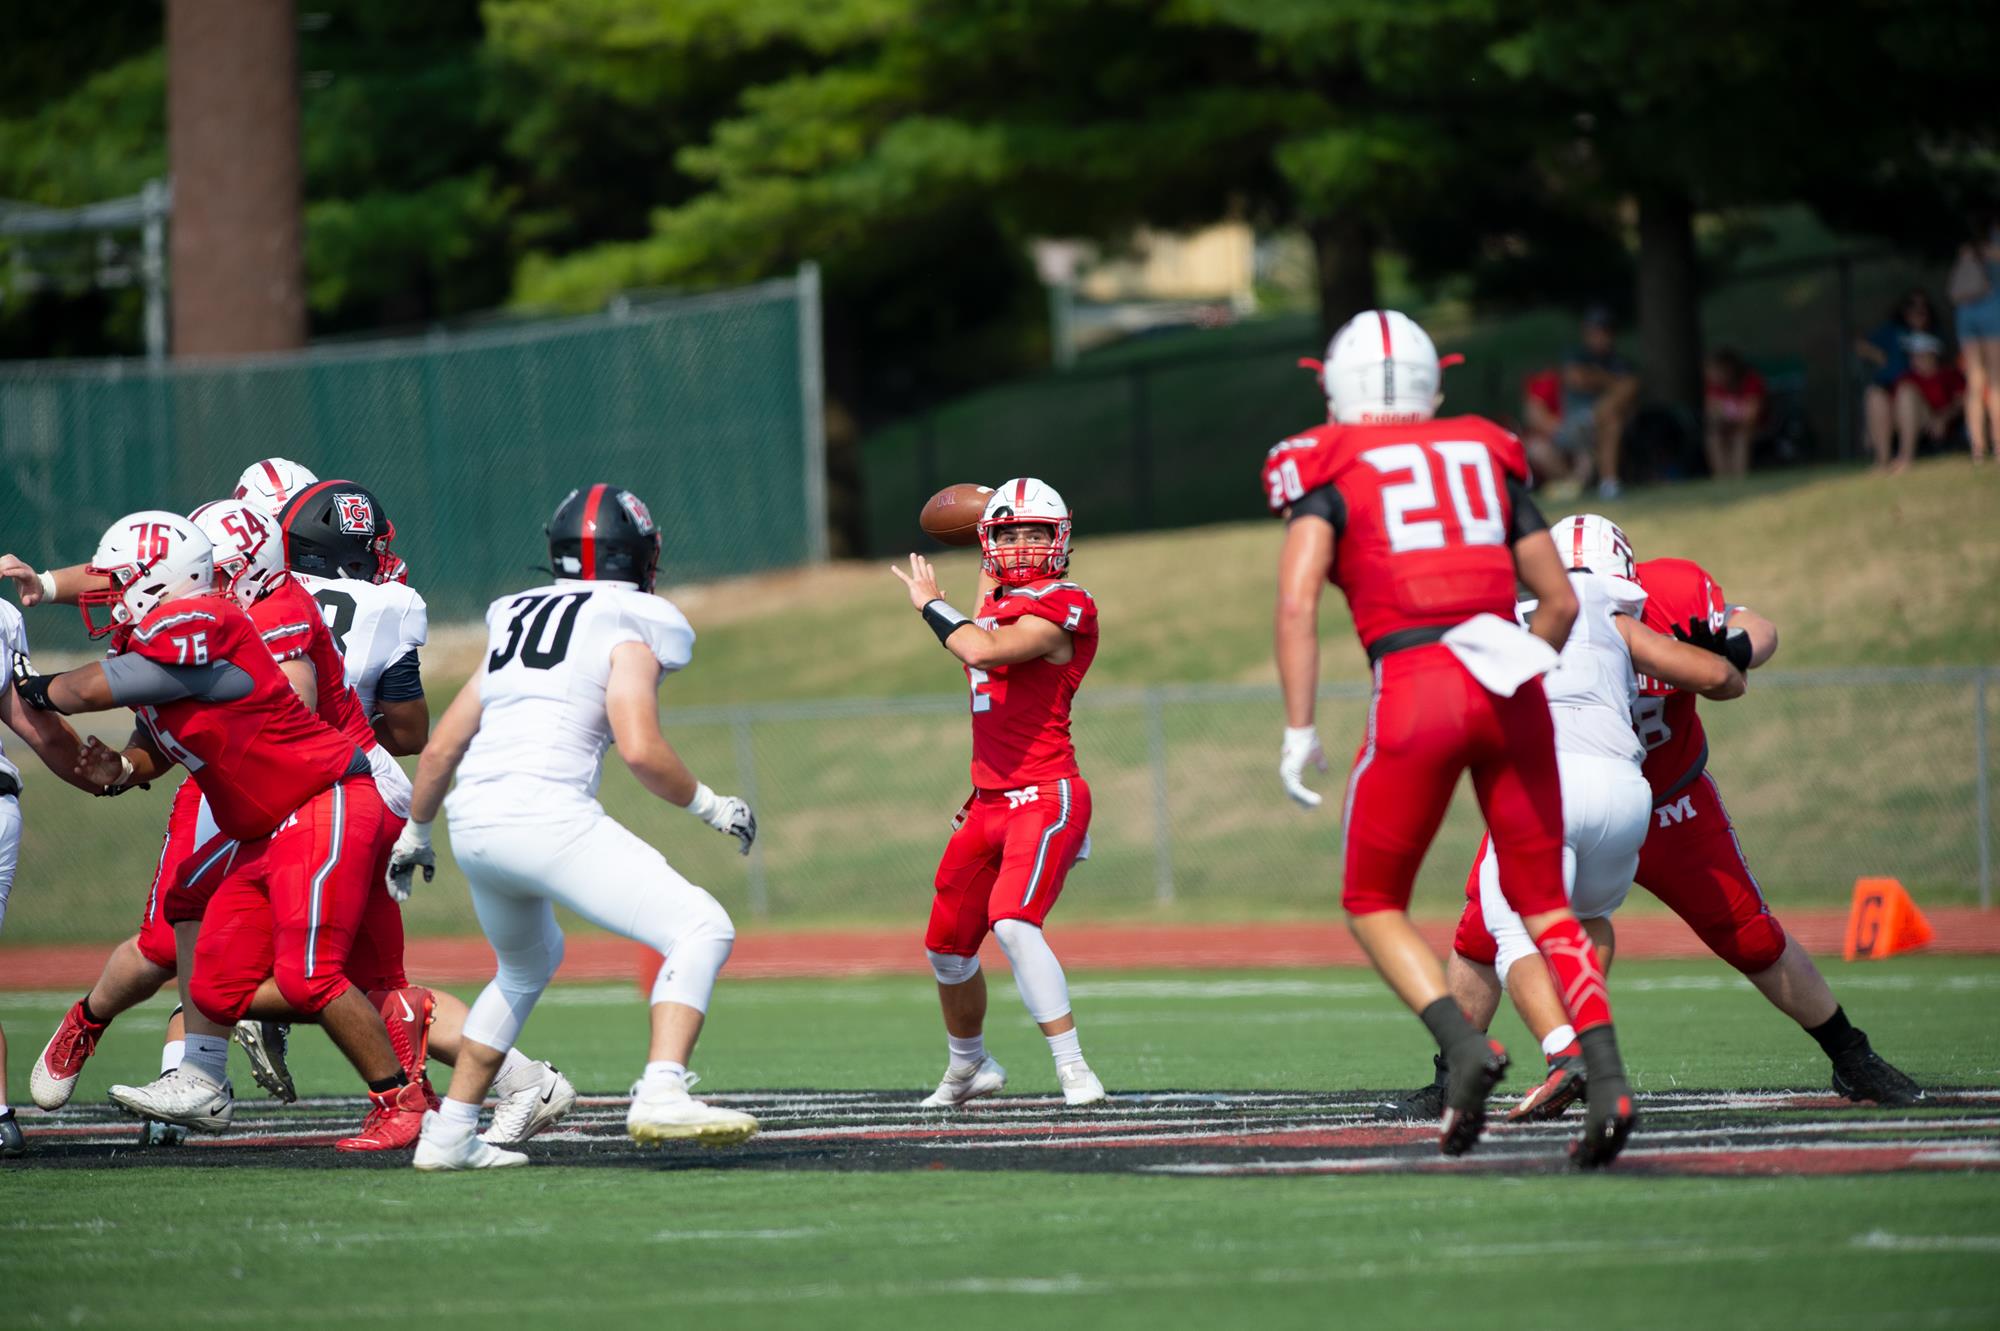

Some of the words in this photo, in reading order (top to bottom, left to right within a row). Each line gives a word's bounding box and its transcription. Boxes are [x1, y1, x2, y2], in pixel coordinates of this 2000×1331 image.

[1268, 458, 1304, 508] 20
[1359, 440, 1506, 553] 20
[221, 508, 270, 551] 54
[350, 504, 365, 522] G
[130, 522, 171, 560] 76
[488, 591, 592, 674] 30
[1064, 605, 1082, 630] 2
[171, 631, 208, 665] 76
[1004, 786, 1038, 809] M
[1654, 795, 1697, 828] M
[1856, 895, 1882, 954] G
